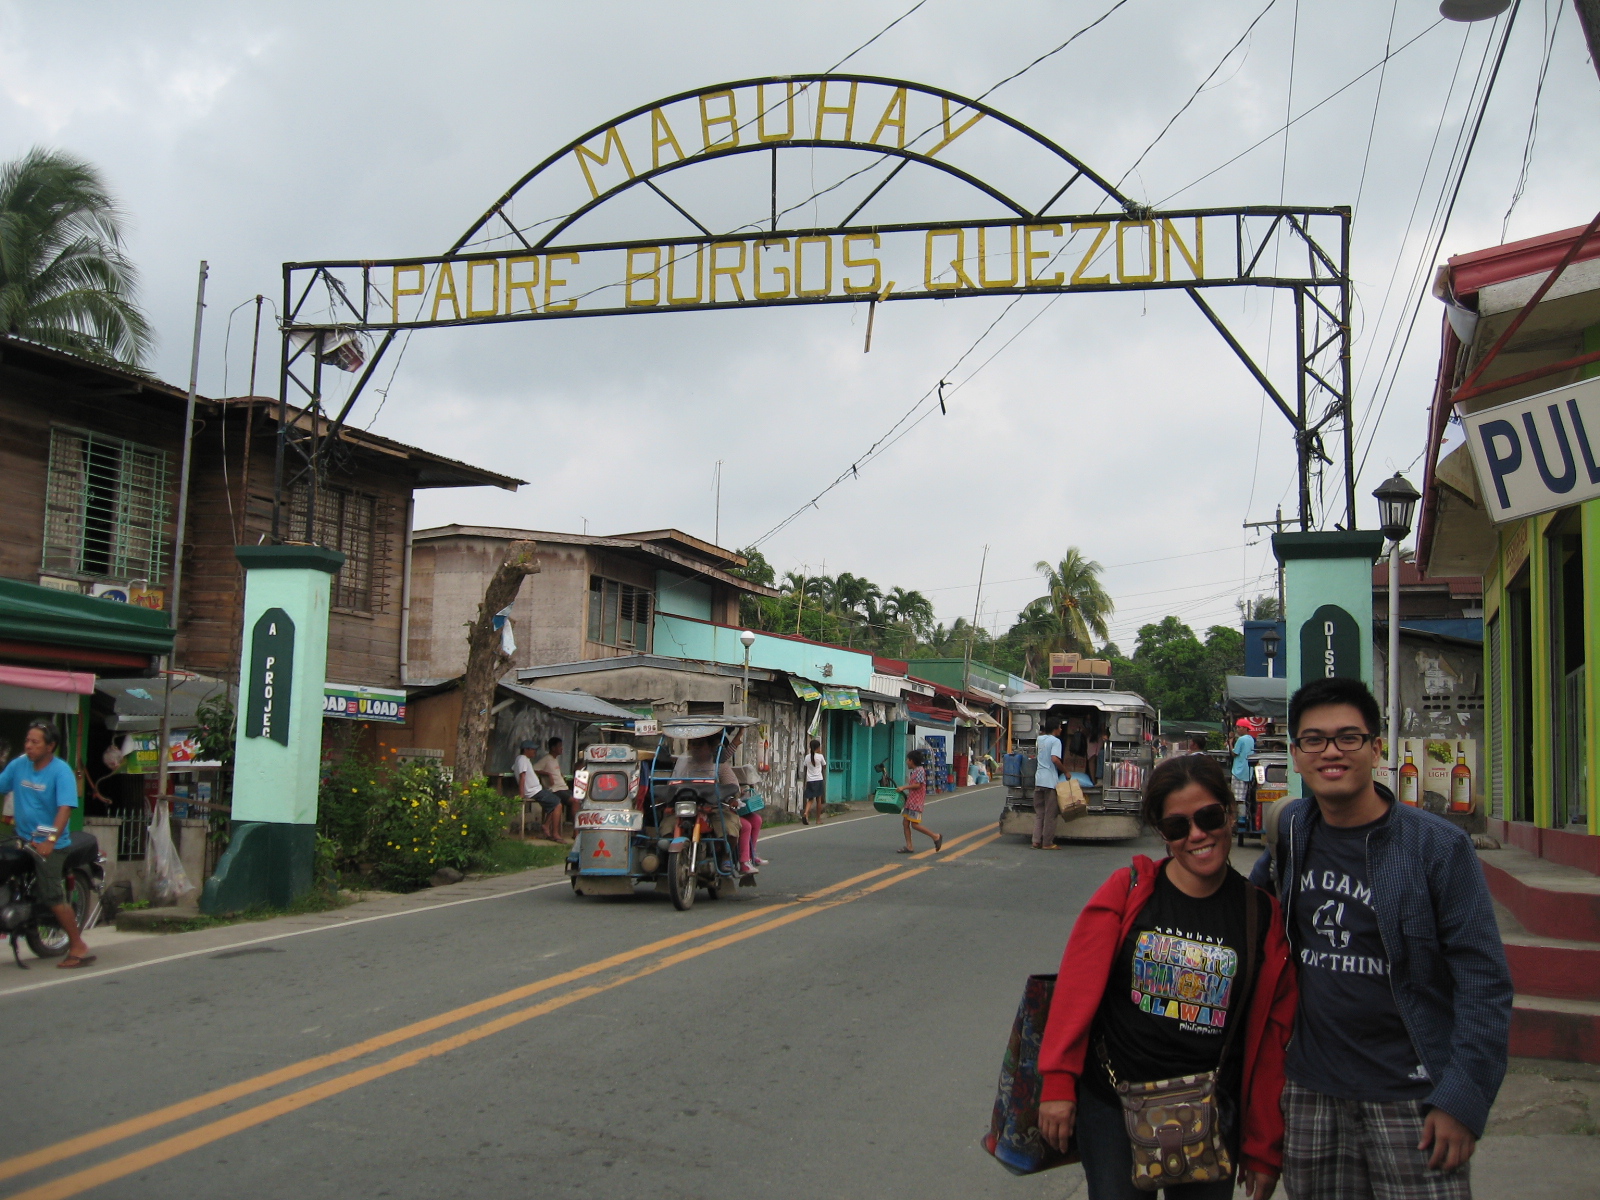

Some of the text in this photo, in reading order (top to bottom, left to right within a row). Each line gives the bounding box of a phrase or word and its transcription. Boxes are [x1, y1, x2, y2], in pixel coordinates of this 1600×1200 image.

[573, 80, 988, 199] MABUHAY
[393, 216, 1204, 323] PADRE BURGOS, QUEZON
[268, 622, 277, 636] A
[1323, 620, 1335, 679] DISC
[359, 699, 398, 716] ULOAD
[1321, 870, 1376, 911] GAM
[1135, 930, 1238, 978] PUERTO
[1132, 957, 1232, 1009] PRINCESA
[1131, 988, 1227, 1028] PALAWAN
